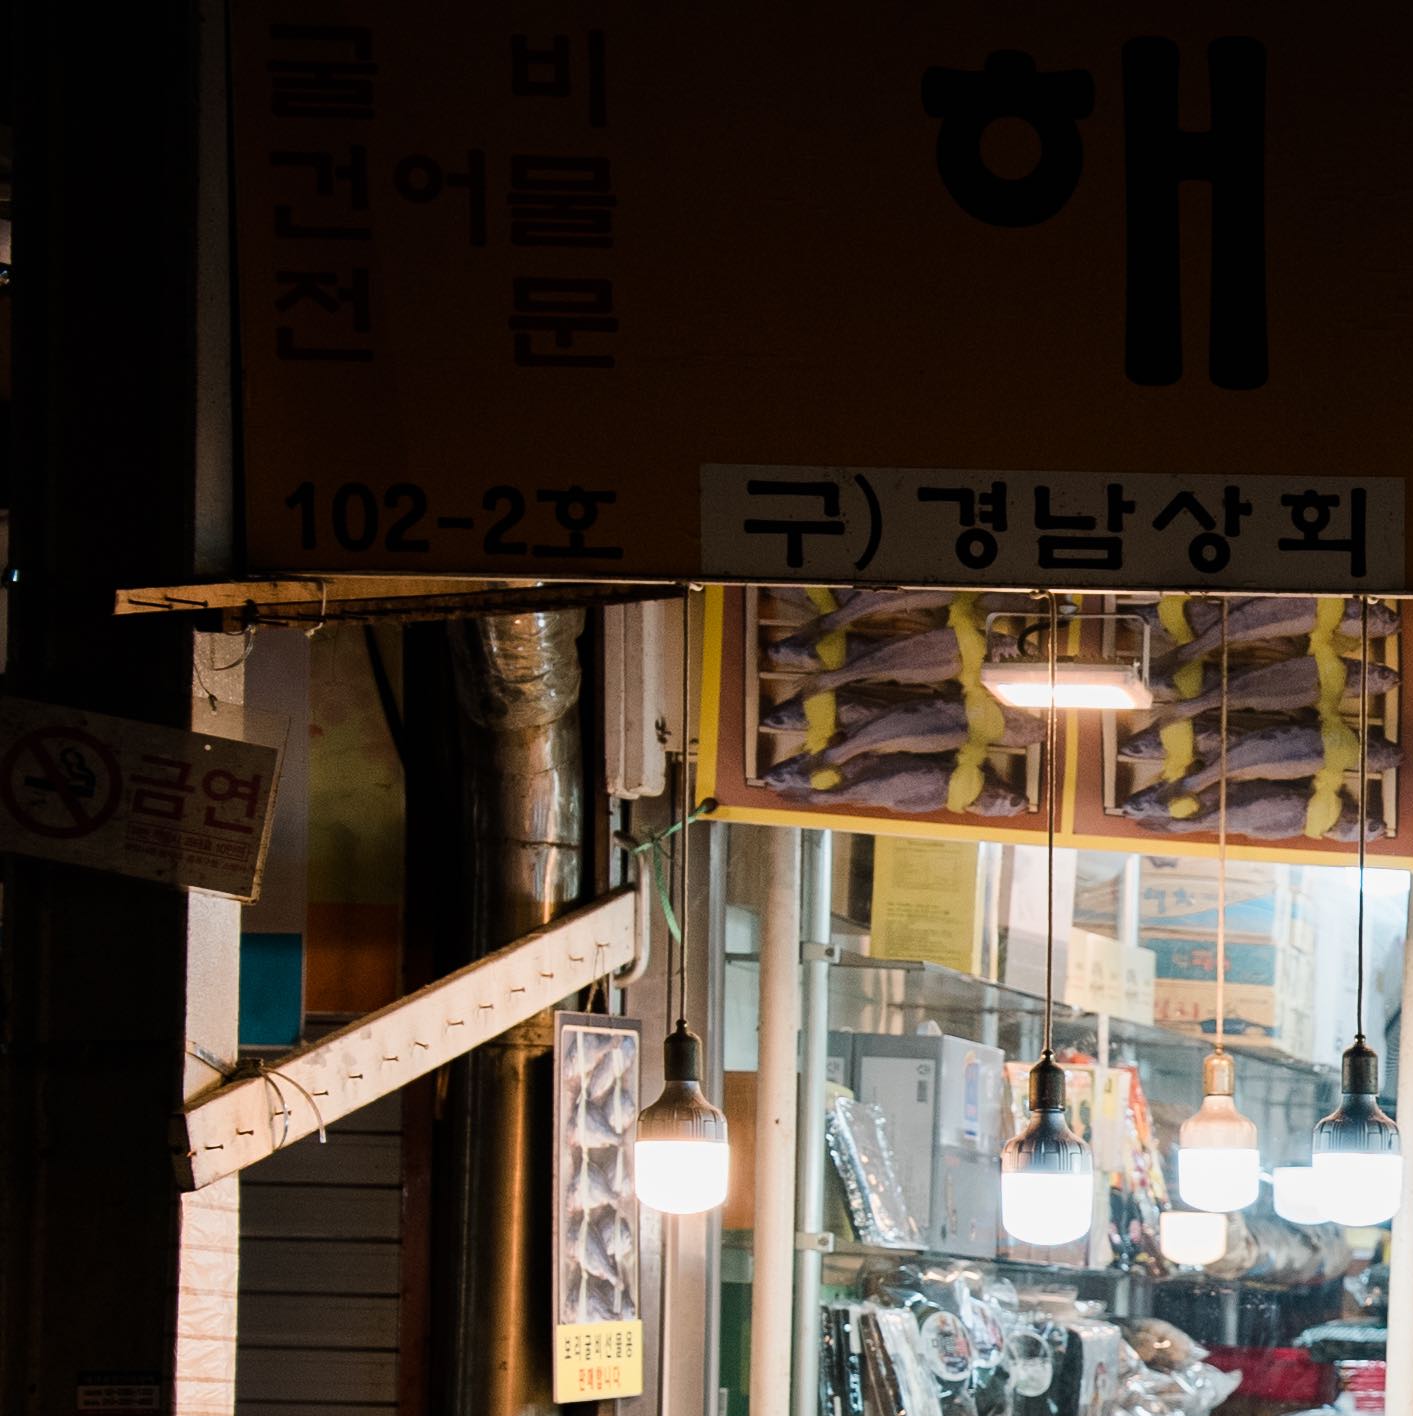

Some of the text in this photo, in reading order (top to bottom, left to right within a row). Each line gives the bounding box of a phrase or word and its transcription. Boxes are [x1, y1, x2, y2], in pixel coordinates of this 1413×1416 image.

[269, 145, 617, 248] 건어물
[285, 480, 622, 560] 102-2호
[917, 481, 1368, 578] 경남상회
[130, 754, 262, 835] 금연
